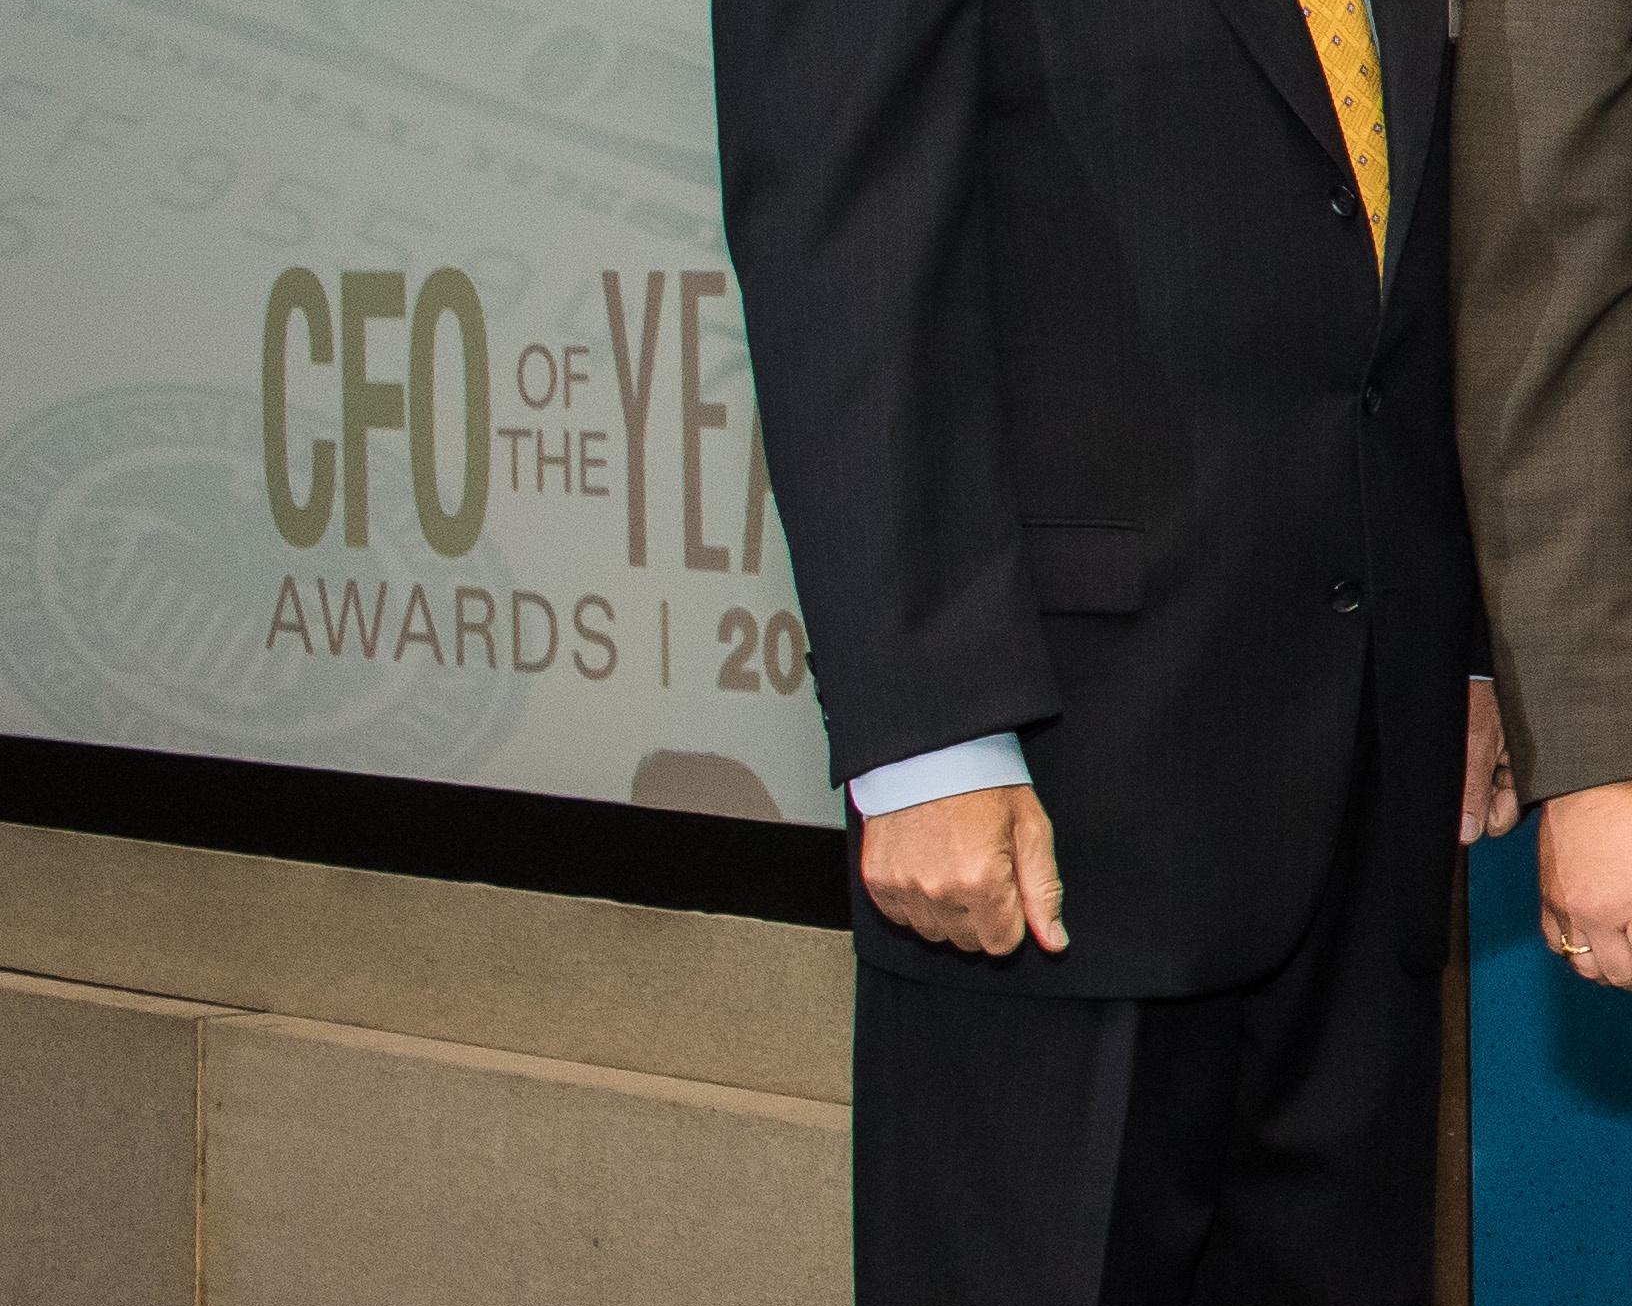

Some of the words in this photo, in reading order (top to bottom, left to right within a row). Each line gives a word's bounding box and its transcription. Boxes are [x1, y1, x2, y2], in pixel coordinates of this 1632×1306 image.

[261, 266, 491, 558] CFO
[516, 342, 590, 410] OF
[497, 427, 610, 498] THE
[265, 576, 619, 682] AWARDS
